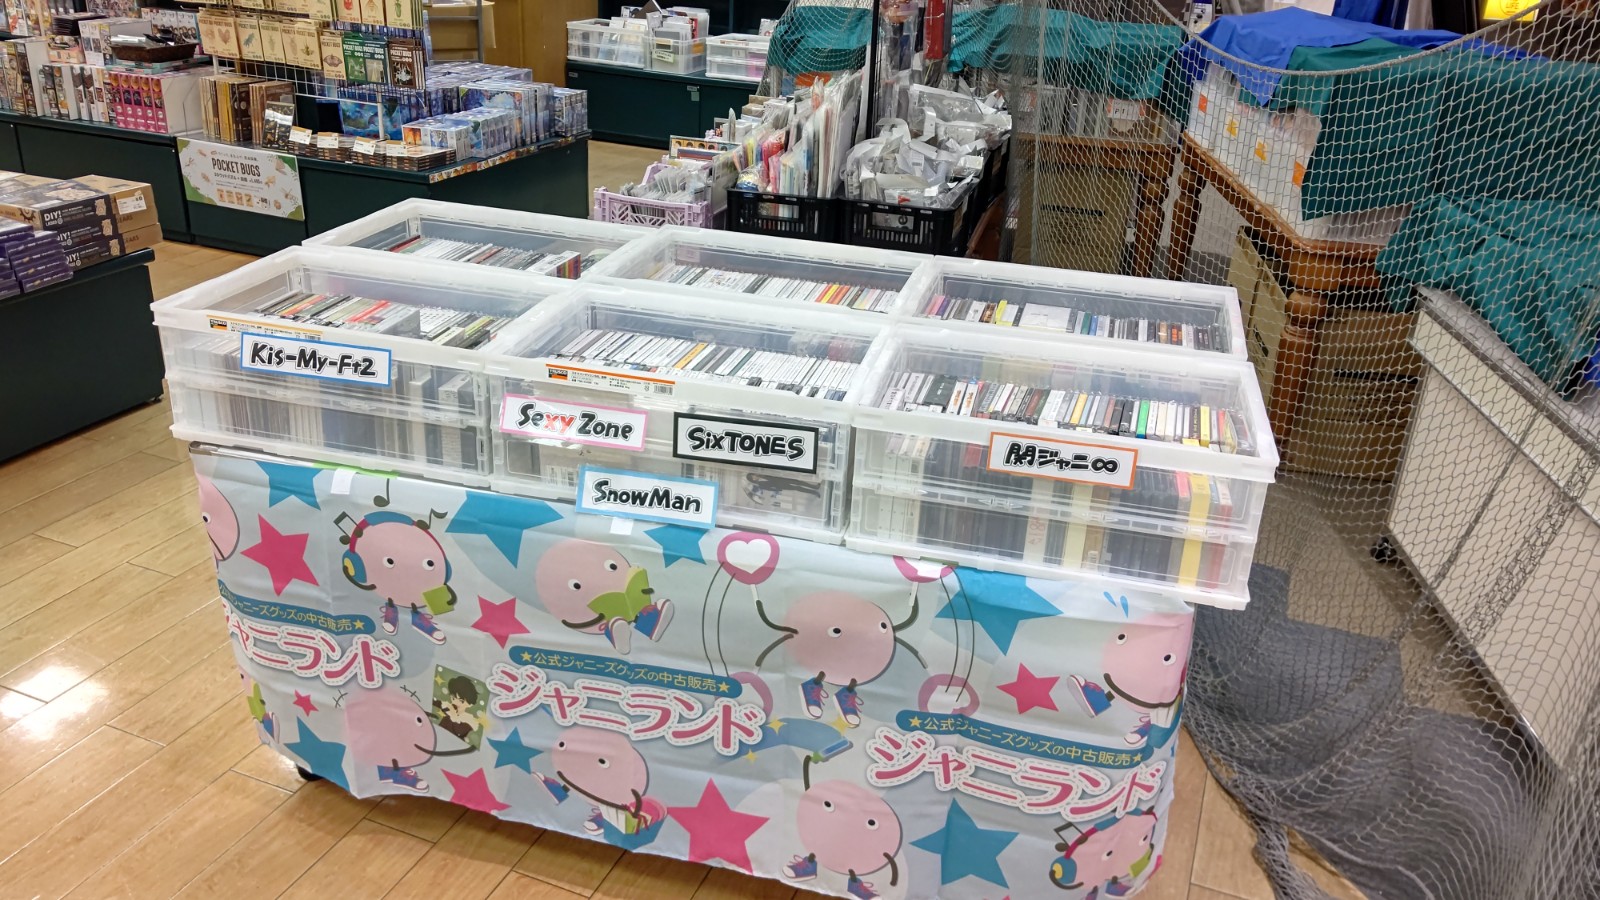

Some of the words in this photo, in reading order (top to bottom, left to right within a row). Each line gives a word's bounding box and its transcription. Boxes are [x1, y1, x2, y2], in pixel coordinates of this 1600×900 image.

[212, 158, 240, 174] POCKET
[240, 162, 261, 177] BUGS
[44, 210, 61, 221] DIY!
[250, 342, 378, 377] Kis-My-Ft2
[517, 402, 576, 432] Sexy
[578, 412, 633, 440] Zone
[687, 427, 804, 460] SixTONES
[1005, 442, 1119, 474] 関ジャニ∞
[593, 480, 703, 514] SnowMan
[533, 652, 718, 691] 公式ジャニーズグッズの中古販売
[490, 668, 757, 750] ジャニランド
[924, 715, 1132, 766] 公式ジャニーズグッズの中古販売
[873, 733, 1165, 817] ジャニランド
